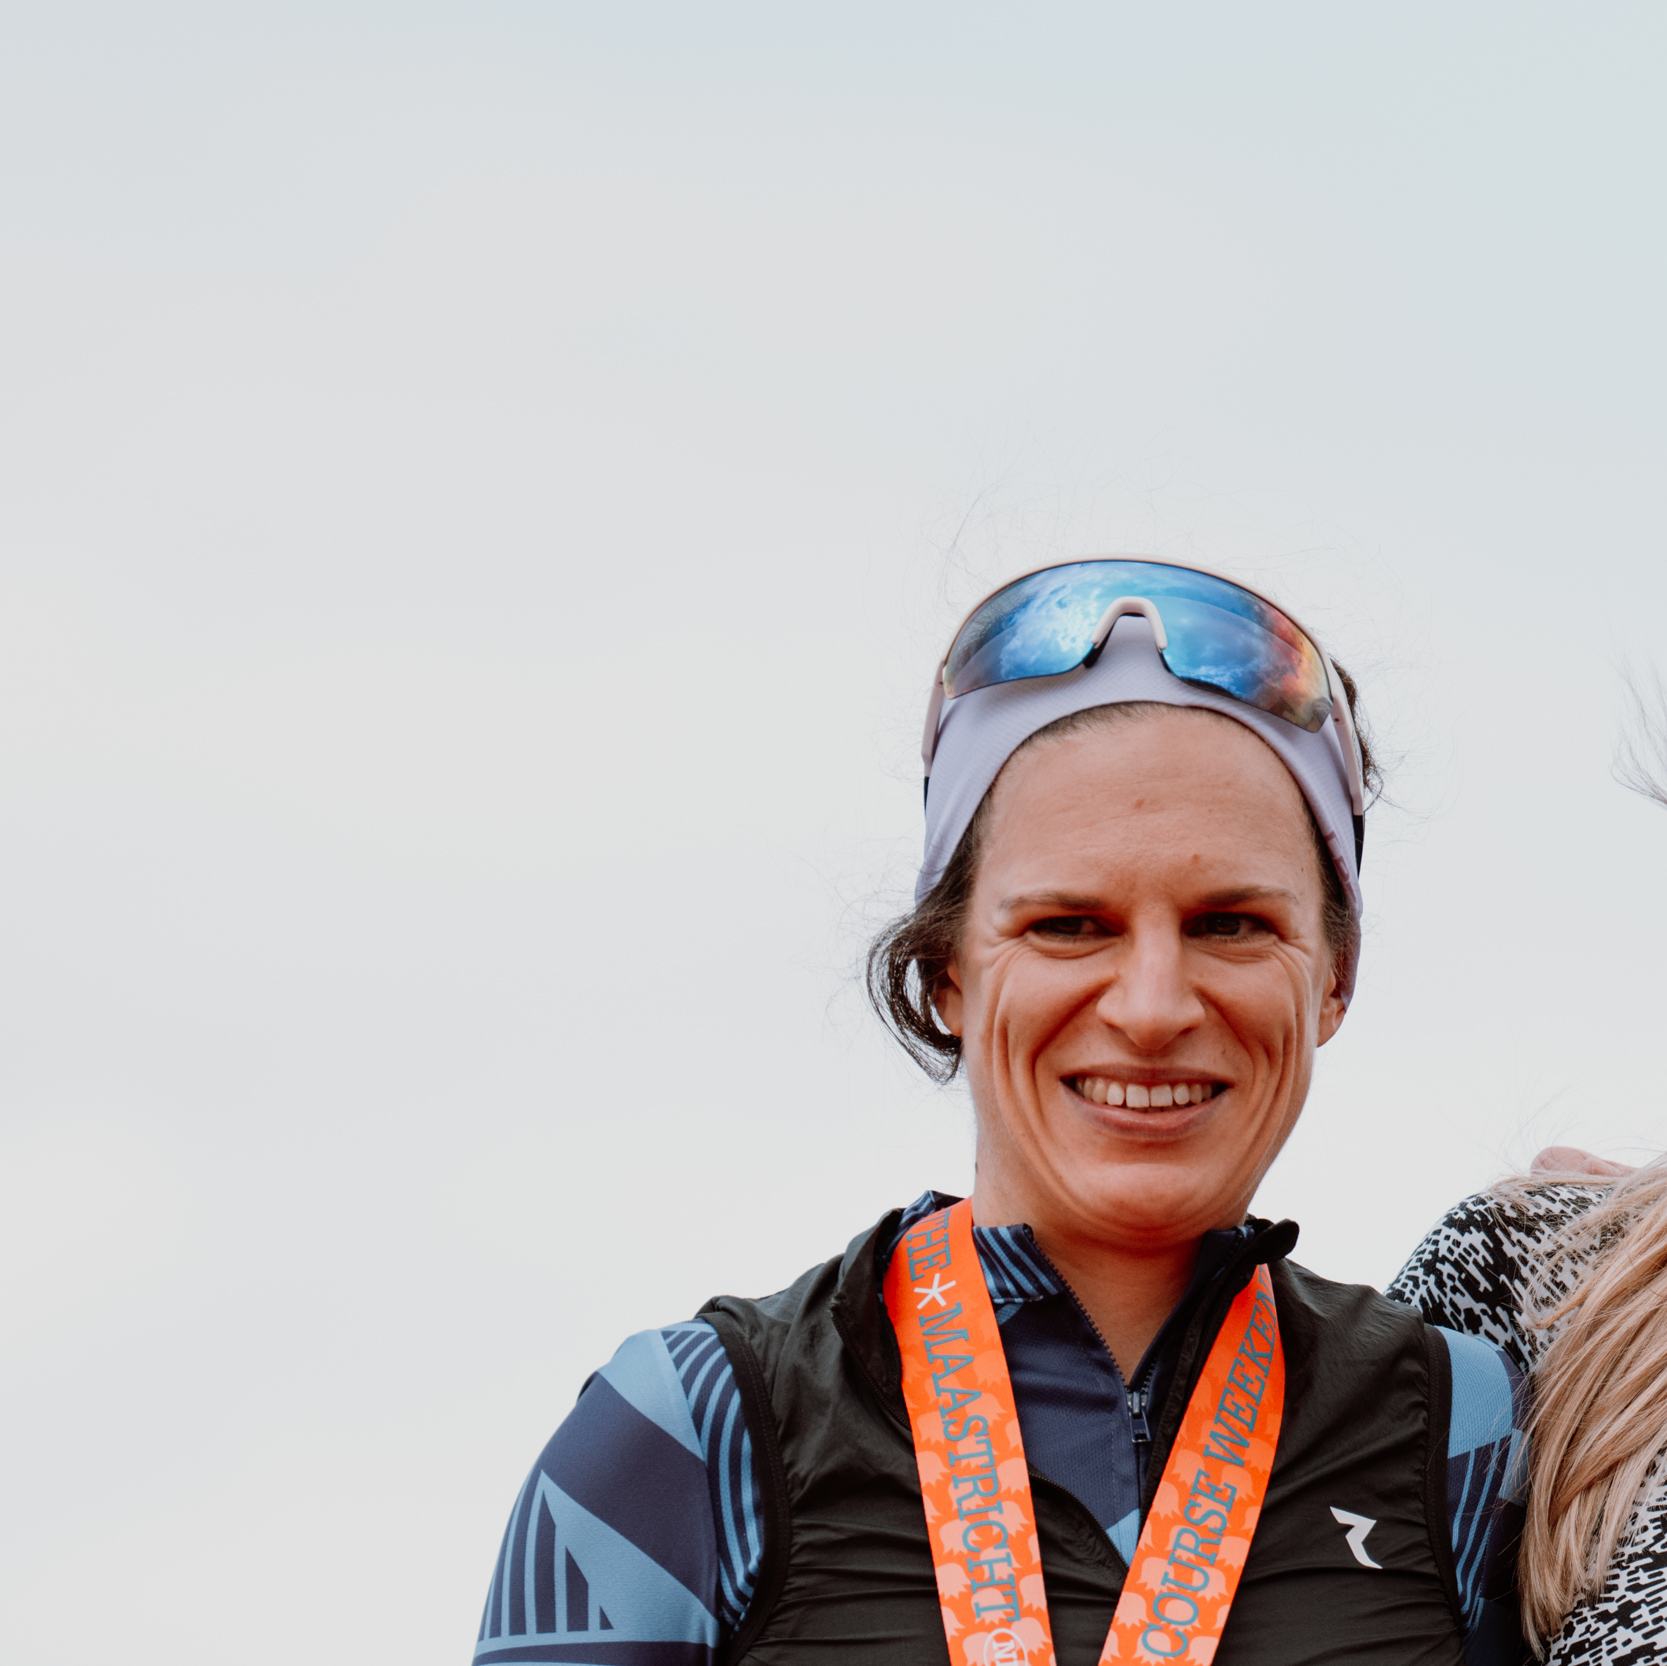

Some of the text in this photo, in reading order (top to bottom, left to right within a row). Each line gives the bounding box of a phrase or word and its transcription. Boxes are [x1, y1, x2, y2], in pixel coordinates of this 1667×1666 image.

[918, 1301, 1022, 1624] MAASTRICHT
[1141, 1470, 1238, 1658] COURSE
[1203, 1264, 1277, 1467] WEEKEN
